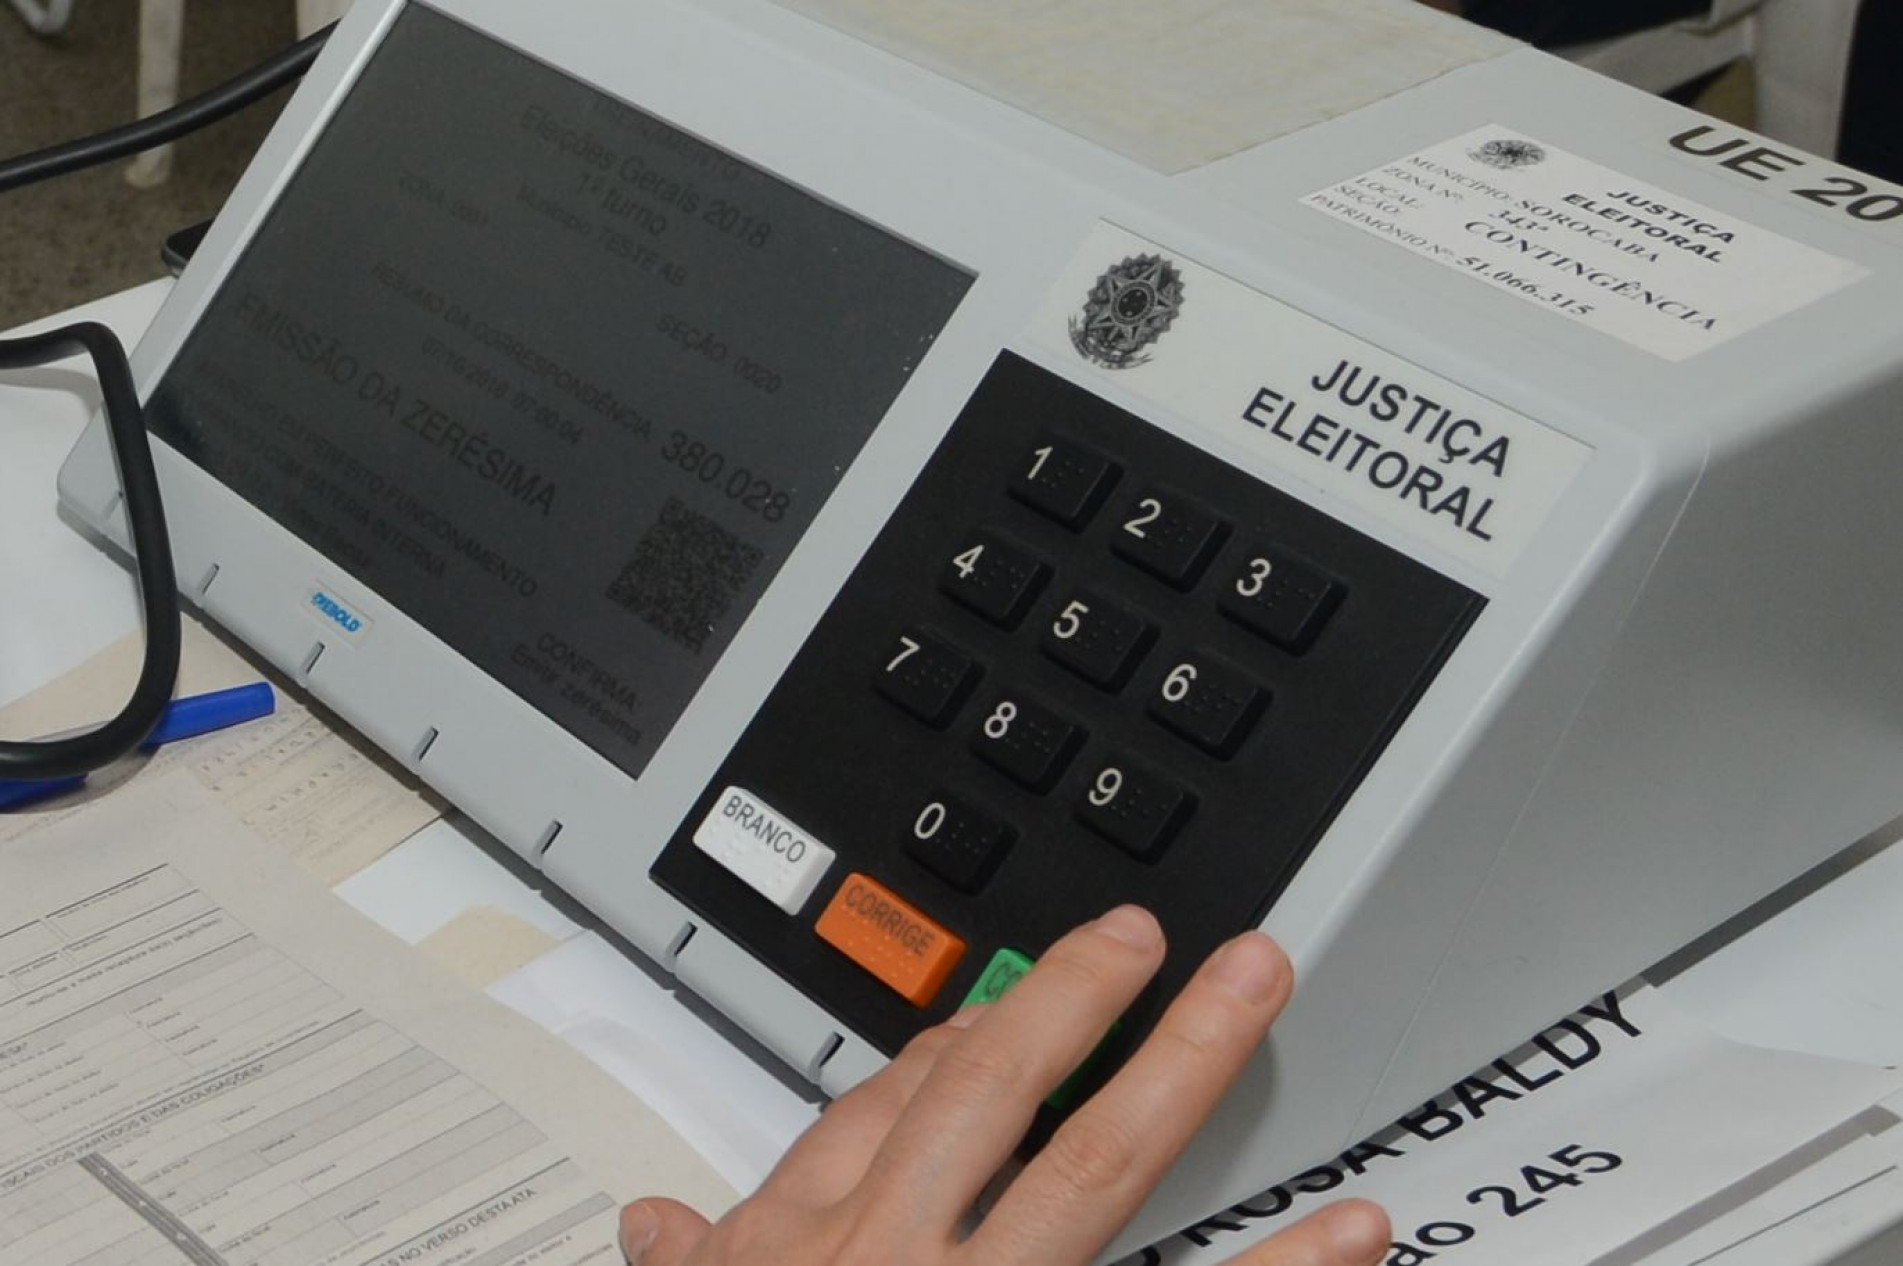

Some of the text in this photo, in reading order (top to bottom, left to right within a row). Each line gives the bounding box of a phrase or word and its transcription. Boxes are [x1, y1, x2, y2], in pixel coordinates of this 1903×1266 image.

[619, 156, 703, 212] Gerais
[704, 200, 771, 247] 2018
[1669, 126, 1903, 221] UE 20
[603, 188, 669, 235] turno
[1515, 199, 1659, 263] SOROCABA
[1562, 193, 1722, 263] ELEITORAL
[1607, 191, 1735, 243] JUSTIÇA
[1456, 255, 1595, 315] 51.066.315
[1464, 221, 1717, 330] CONTINGÊNCIA
[236, 288, 562, 515] EMISSÃO DA ZERÉSIMA
[1311, 360, 1510, 478] JUSTIÇA
[662, 431, 790, 522] 380.028
[1027, 445, 1054, 480] 1
[1242, 386, 1495, 542] ELEITORAL
[1123, 498, 1162, 538] 2
[953, 544, 985, 579] 4
[1236, 558, 1272, 598] 3
[1052, 599, 1089, 639] 5
[886, 636, 921, 672] 7
[1162, 663, 1198, 702] 6
[983, 701, 1018, 739] 8
[1088, 767, 1123, 806] 9
[722, 795, 807, 864] BRANCO
[913, 802, 946, 840] 0
[844, 884, 936, 956] CORRIGE
[1398, 989, 1642, 1142] BALDY
[1466, 1144, 1623, 1217] 245
[423, 1222, 470, 1251] VERSO
